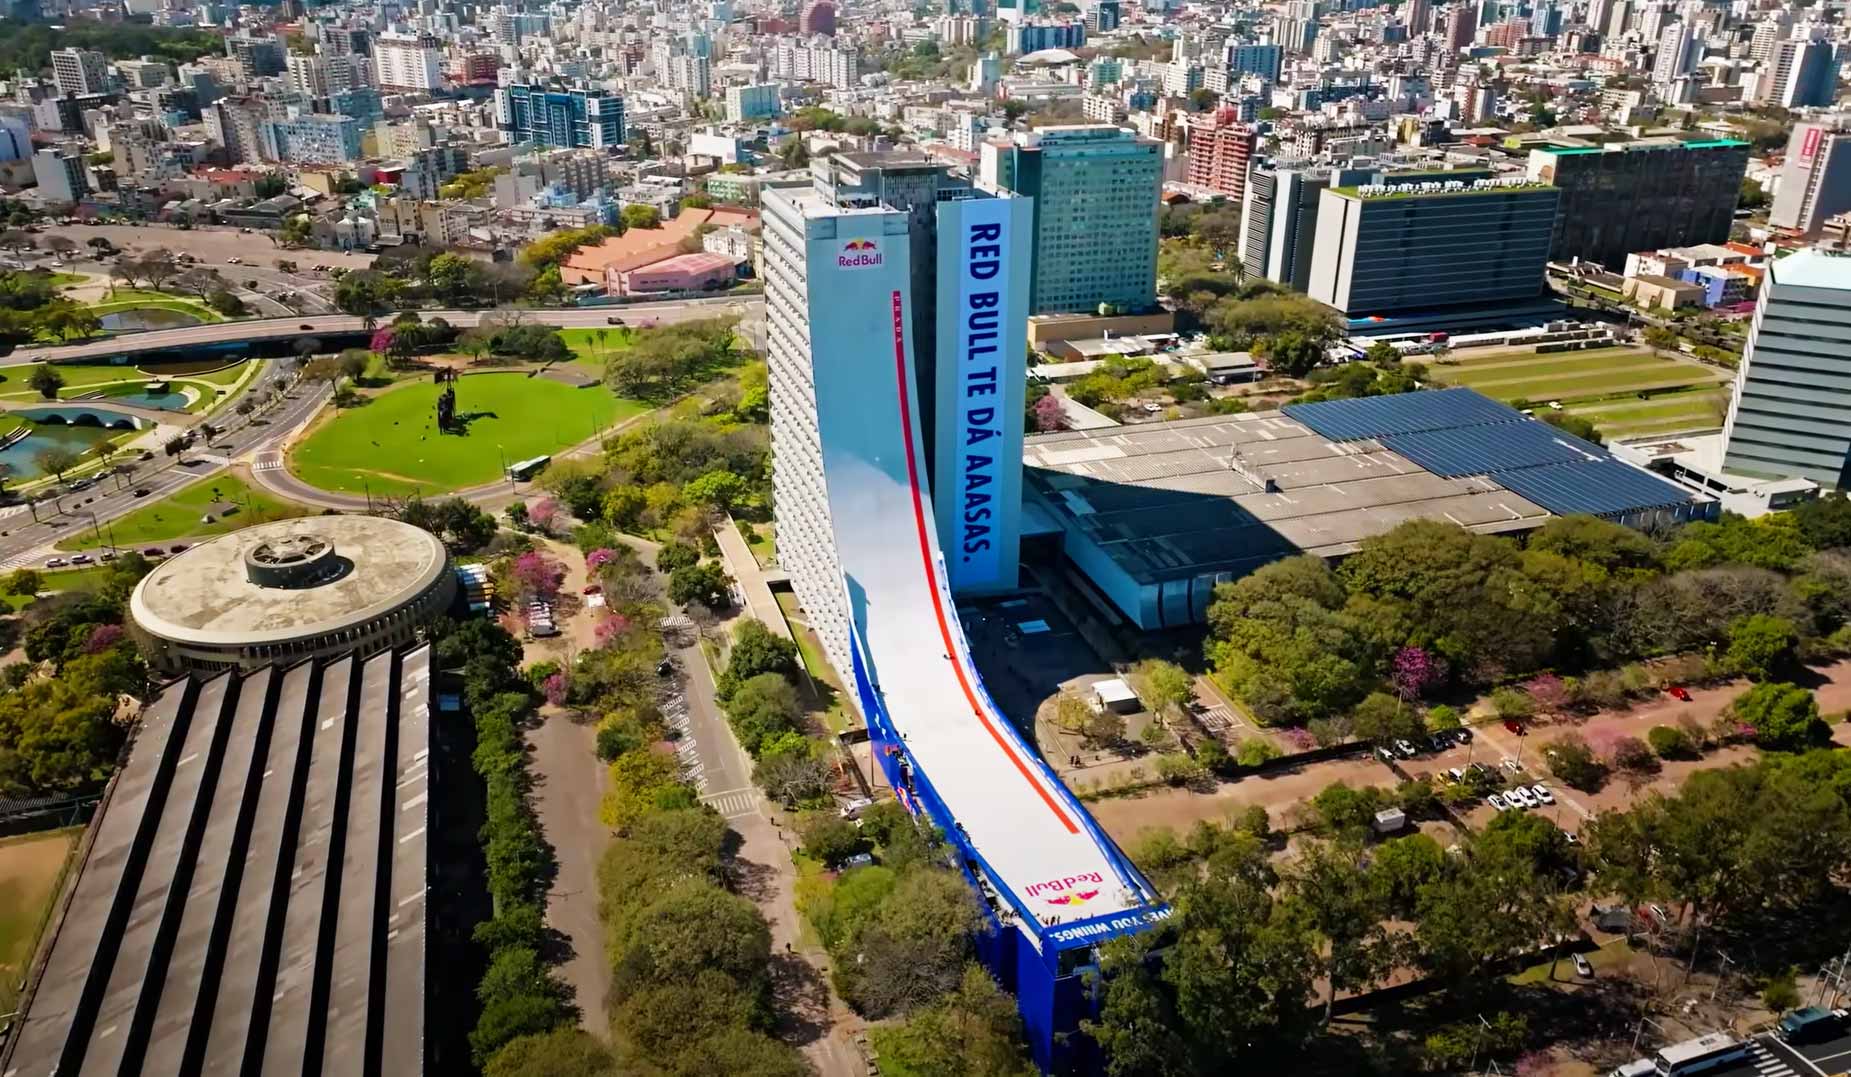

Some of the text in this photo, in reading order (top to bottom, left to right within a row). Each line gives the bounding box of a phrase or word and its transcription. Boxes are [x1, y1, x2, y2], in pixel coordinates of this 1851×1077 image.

[838, 252, 882, 267] Red Bull
[963, 223, 1002, 563] RED BULL TE DÁ AAASAS.
[1025, 872, 1103, 897] Red Bull
[1111, 916, 1144, 929] YOU
